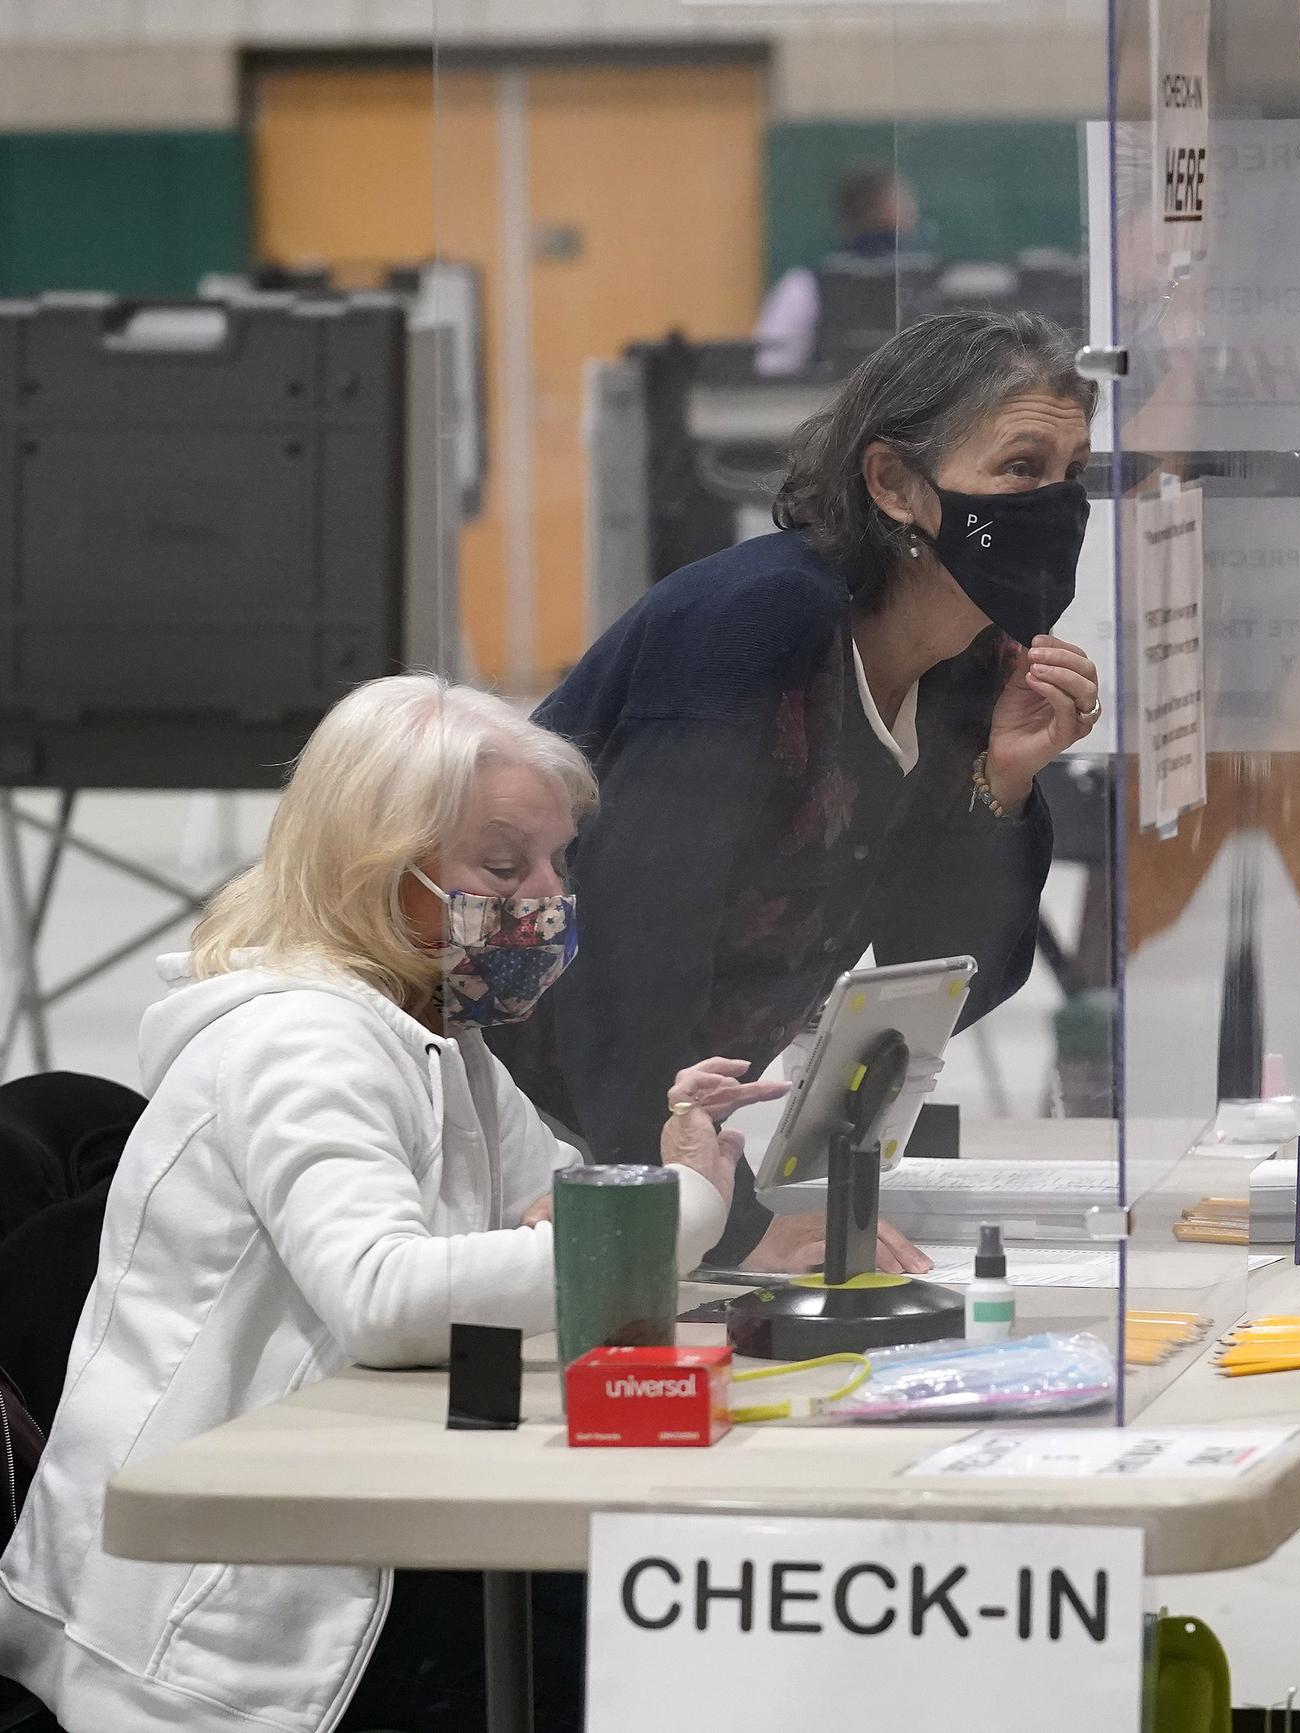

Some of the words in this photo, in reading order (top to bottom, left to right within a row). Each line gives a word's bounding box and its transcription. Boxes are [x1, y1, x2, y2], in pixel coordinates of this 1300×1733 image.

[1164, 147, 1206, 212] HERE
[605, 1374, 697, 1398] universal
[621, 1557, 1108, 1642] CHECK-IN
